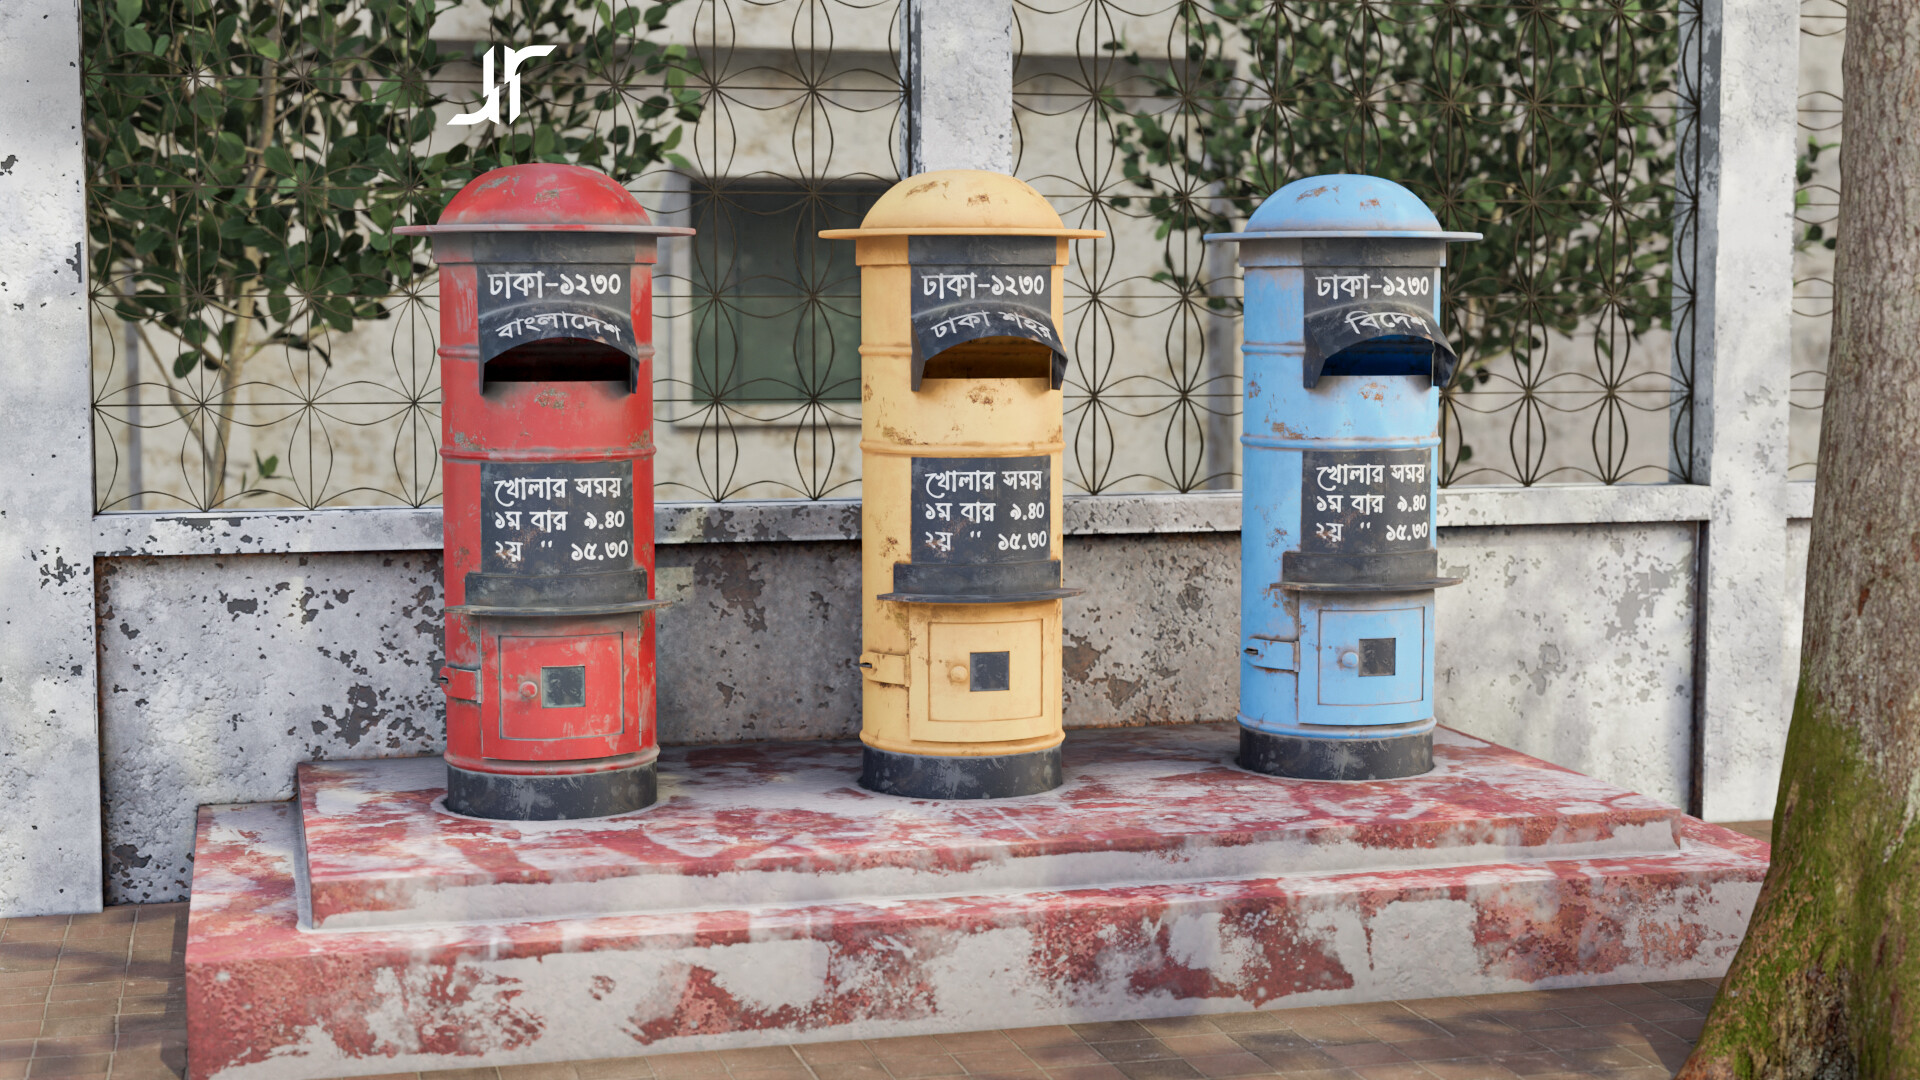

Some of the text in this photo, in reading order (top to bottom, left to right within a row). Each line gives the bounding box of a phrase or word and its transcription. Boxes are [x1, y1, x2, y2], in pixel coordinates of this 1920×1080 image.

[487, 271, 621, 299] ঢাকা-১২৩০
[921, 272, 1044, 300] ঢাকা-১২৩০
[1315, 274, 1429, 300] ঢাকা-১২৩০
[495, 311, 621, 341] বাংলাদেশ
[930, 310, 1053, 341] ঢাকা শহর
[1344, 310, 1431, 335] বিদেশ
[925, 470, 1043, 499] খোলার সময়
[1316, 463, 1425, 491] খোলার সময়
[494, 477, 622, 507] খোলার সময়
[1316, 493, 1427, 515] ১ম বার ৯.৪০
[494, 510, 625, 533] ১ম বার ৯.৪০
[925, 501, 1045, 523] ১ম বার ৯.৪০
[925, 531, 953, 552] ২য়
[998, 531, 1047, 551] ১৫.৩০
[1316, 522, 1344, 542] ২য়
[1386, 522, 1428, 541] ১৫.৩০
[495, 541, 523, 562] ২য়
[571, 540, 628, 561] ১৫.৩০
